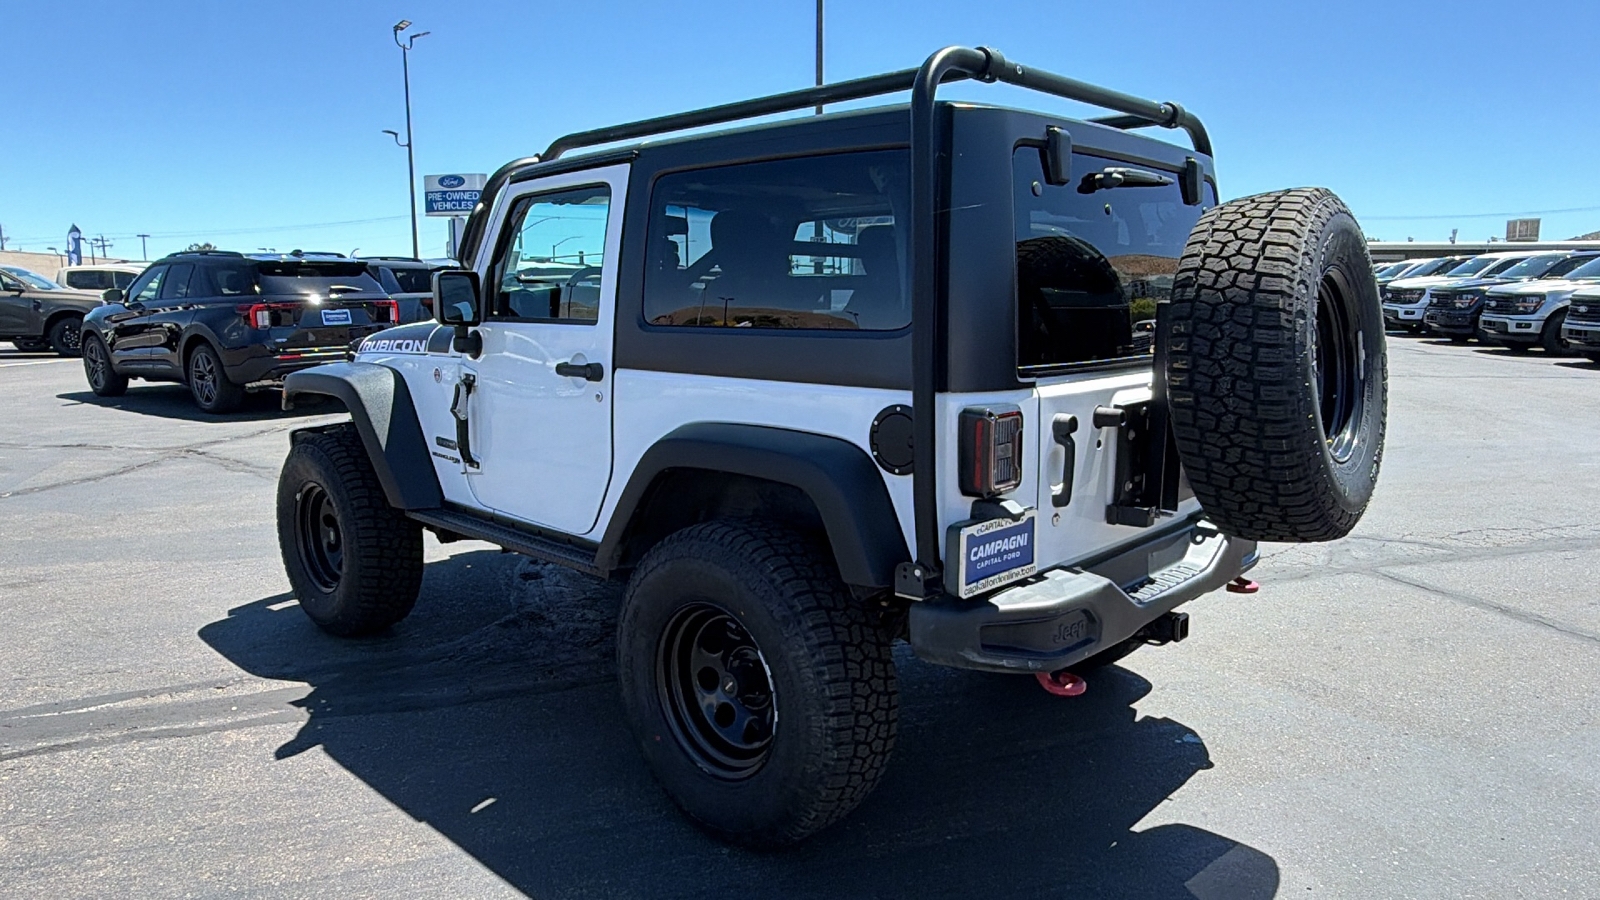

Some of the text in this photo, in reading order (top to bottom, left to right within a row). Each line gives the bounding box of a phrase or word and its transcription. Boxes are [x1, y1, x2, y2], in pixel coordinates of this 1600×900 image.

[442, 177, 459, 186] Ford
[427, 191, 480, 201] PRE-OWNED
[432, 201, 474, 210] VEHICLES
[360, 339, 427, 352] RUBICON
[970, 533, 1029, 562] CAMPAGNI
[976, 551, 1021, 570] CAPITAL FORD
[1053, 619, 1086, 644] Jeep
